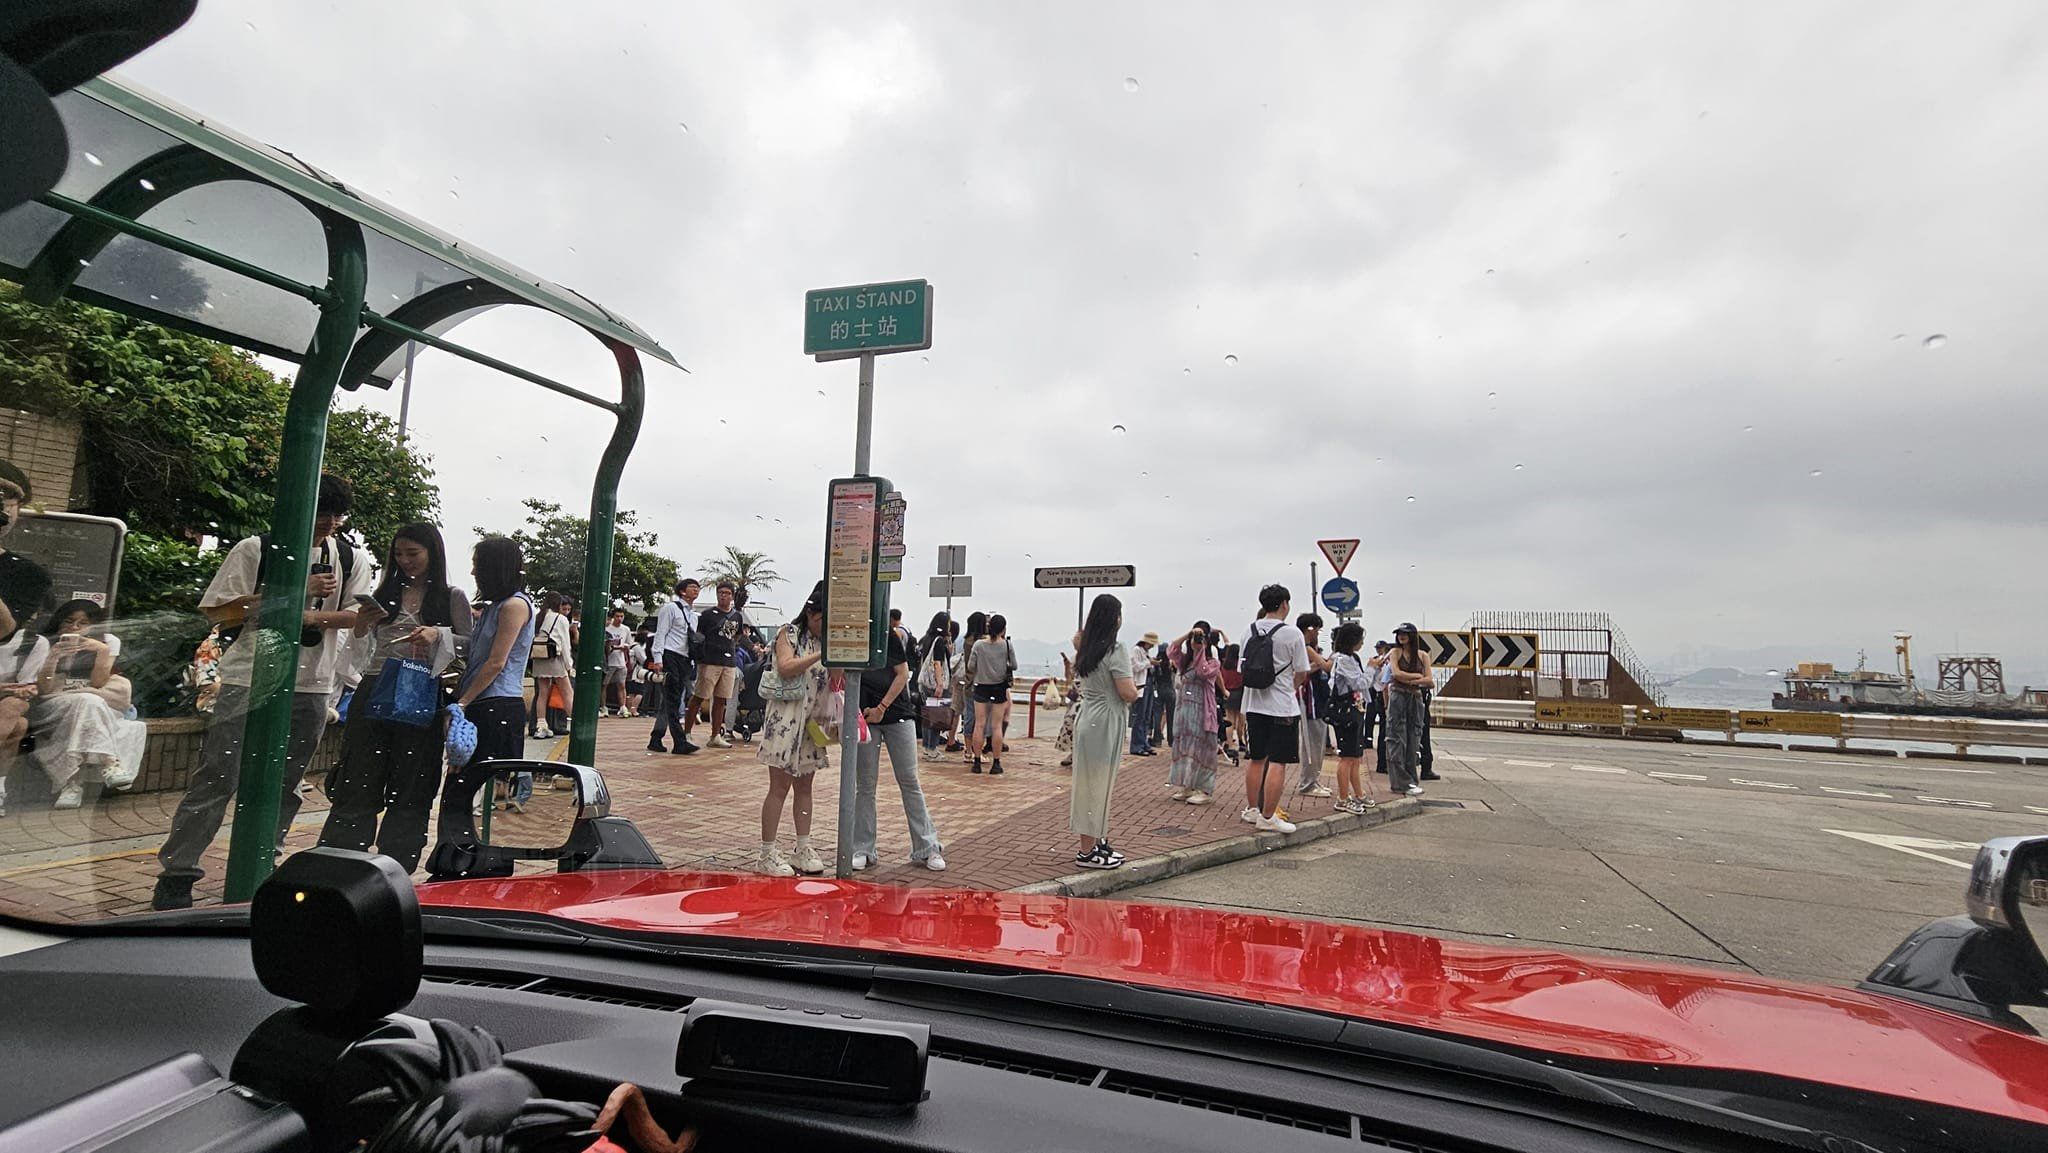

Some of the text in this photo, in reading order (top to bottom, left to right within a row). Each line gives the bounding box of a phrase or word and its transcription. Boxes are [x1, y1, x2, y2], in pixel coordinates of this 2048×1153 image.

[813, 289, 917, 313] TAXI STAND
[830, 315, 897, 340] 的士站
